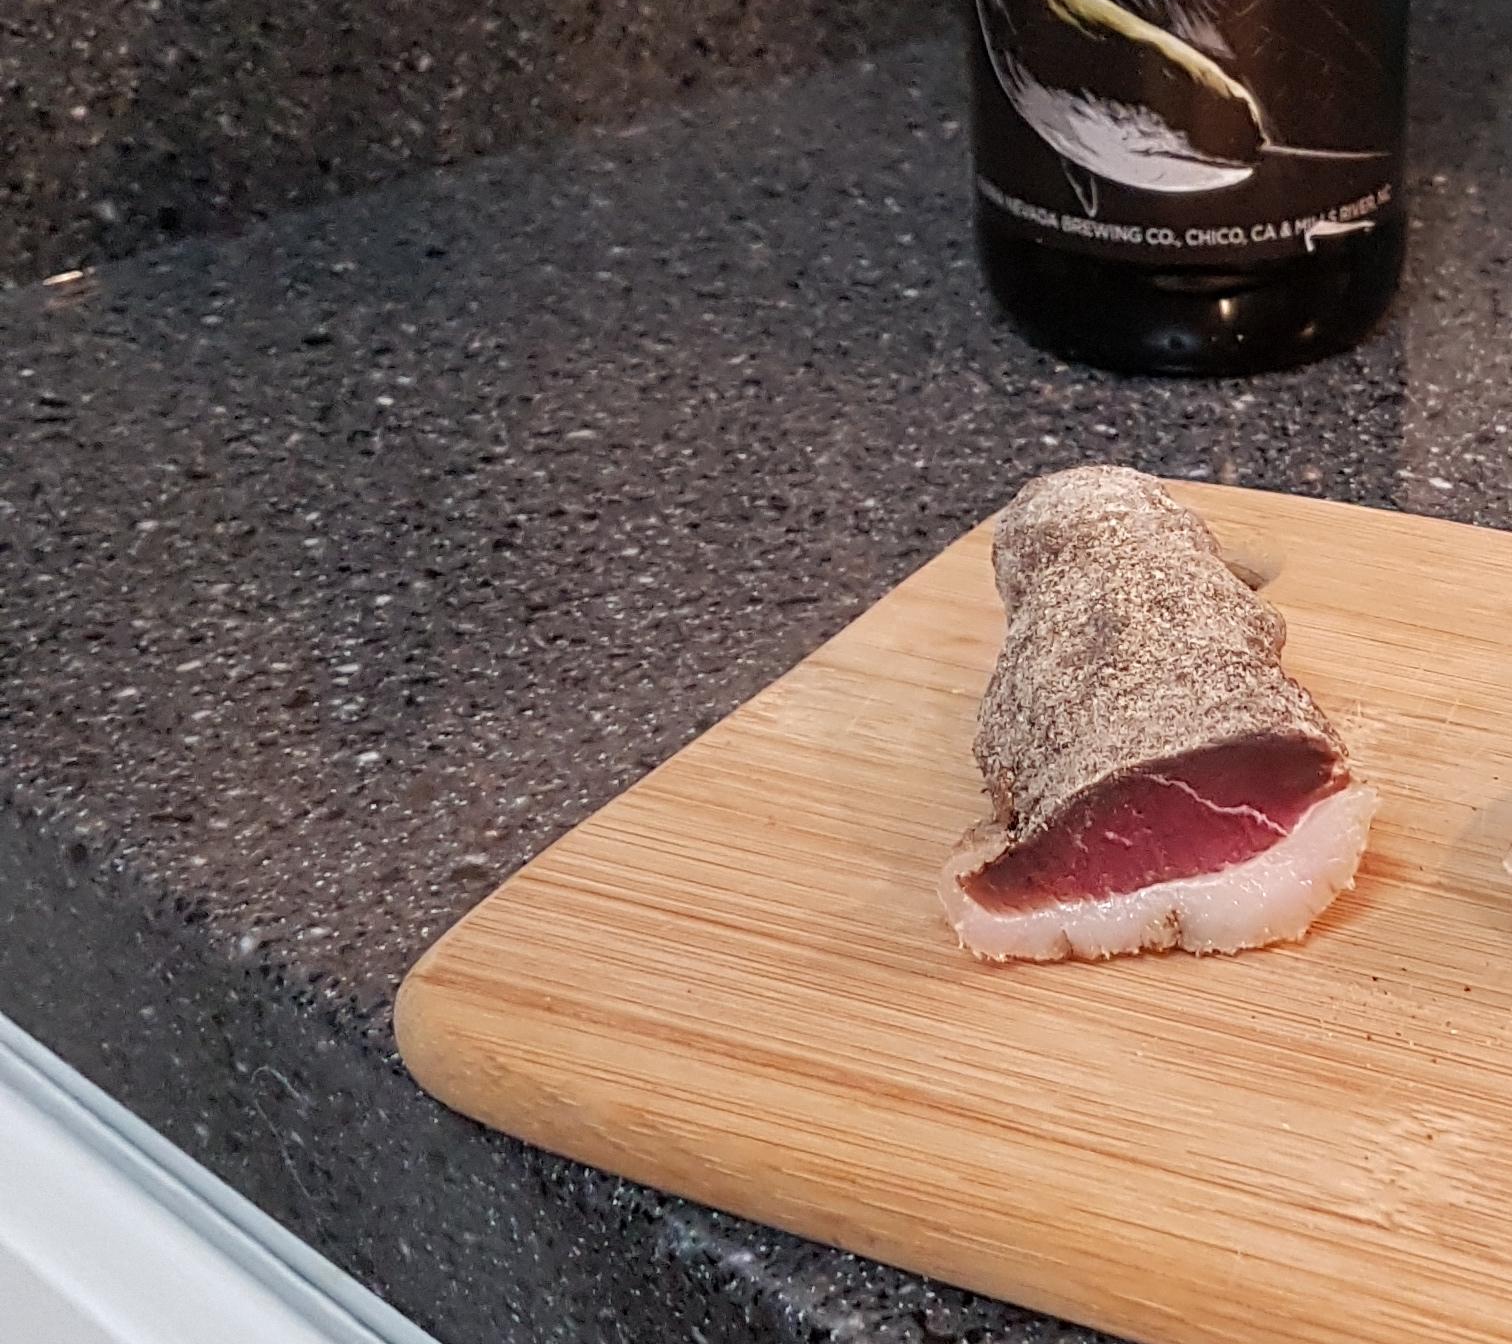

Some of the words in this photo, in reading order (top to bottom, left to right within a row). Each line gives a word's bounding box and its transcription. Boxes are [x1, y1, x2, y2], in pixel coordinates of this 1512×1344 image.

[1061, 214, 1143, 244] BREWING
[1185, 226, 1248, 247] CHICO,
[1251, 222, 1277, 242] CA
[1279, 220, 1292, 238] &
